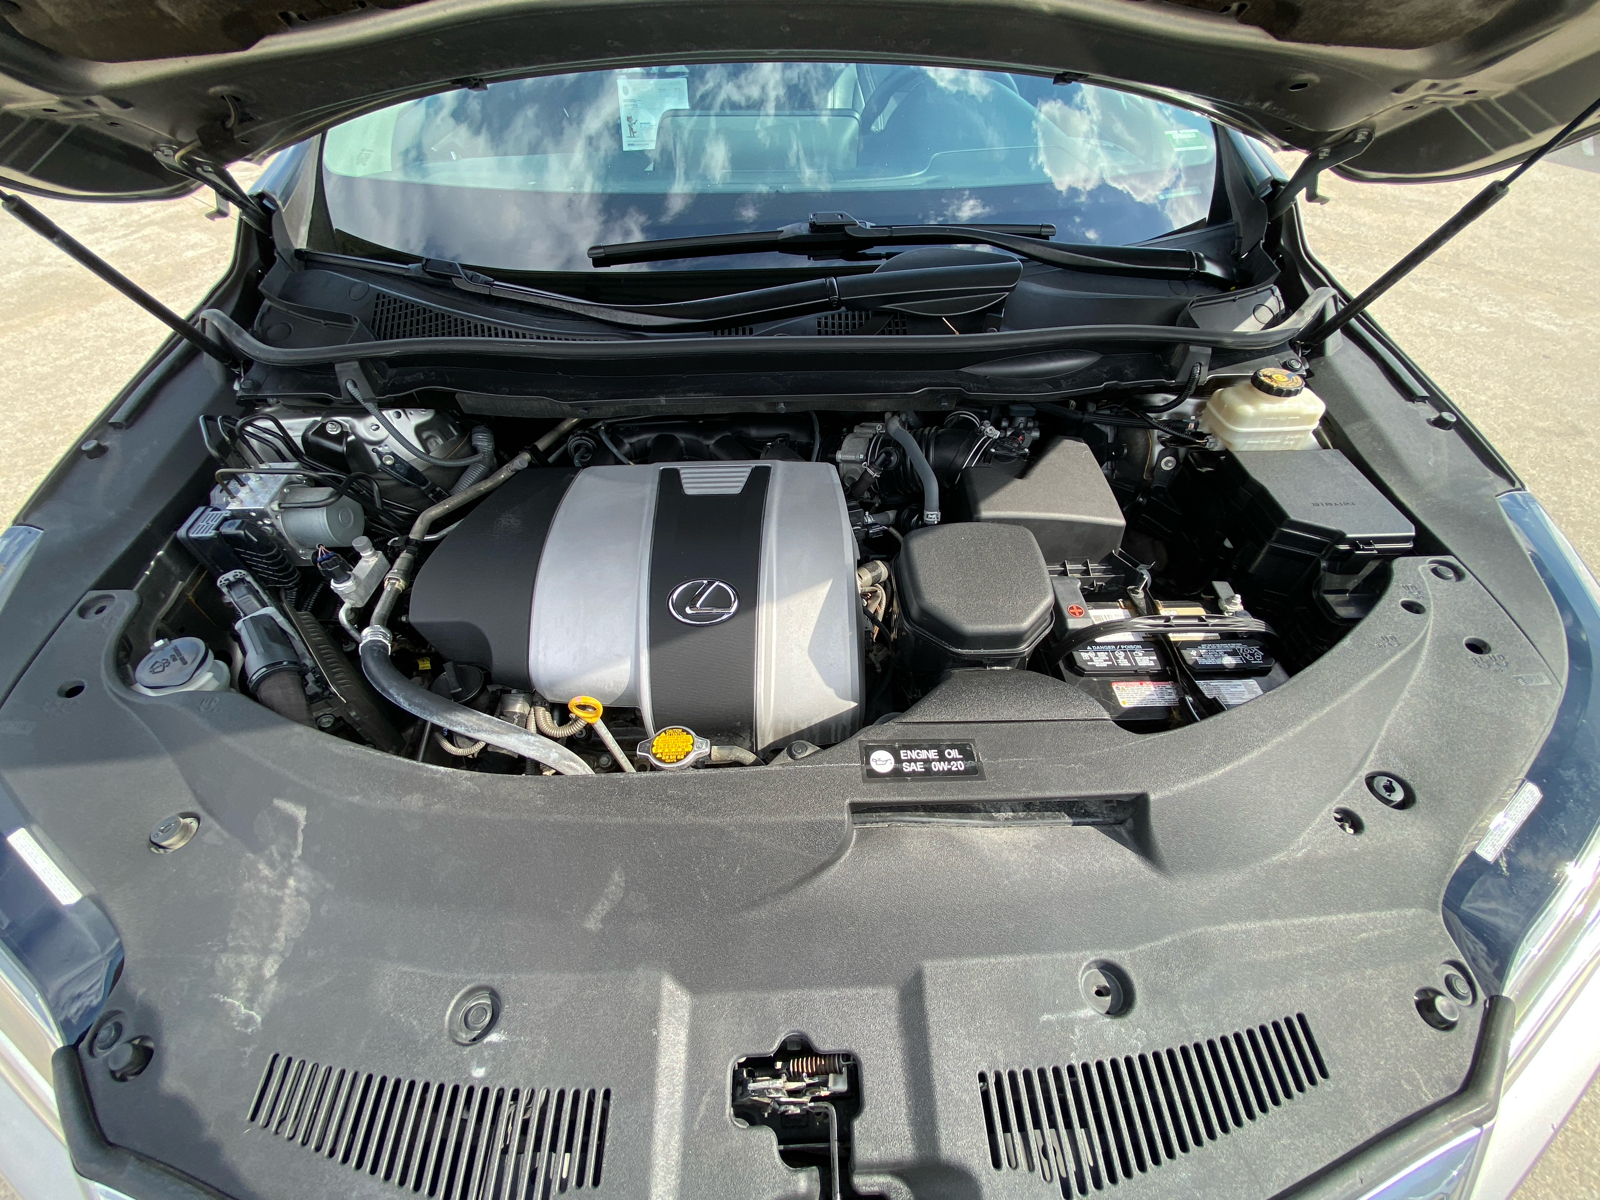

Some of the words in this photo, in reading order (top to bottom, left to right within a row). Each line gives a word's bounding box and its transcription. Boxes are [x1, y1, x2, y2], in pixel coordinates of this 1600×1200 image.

[900, 749, 939, 759] ENGINE
[944, 749, 963, 758] OIL
[902, 762, 925, 772] SAE
